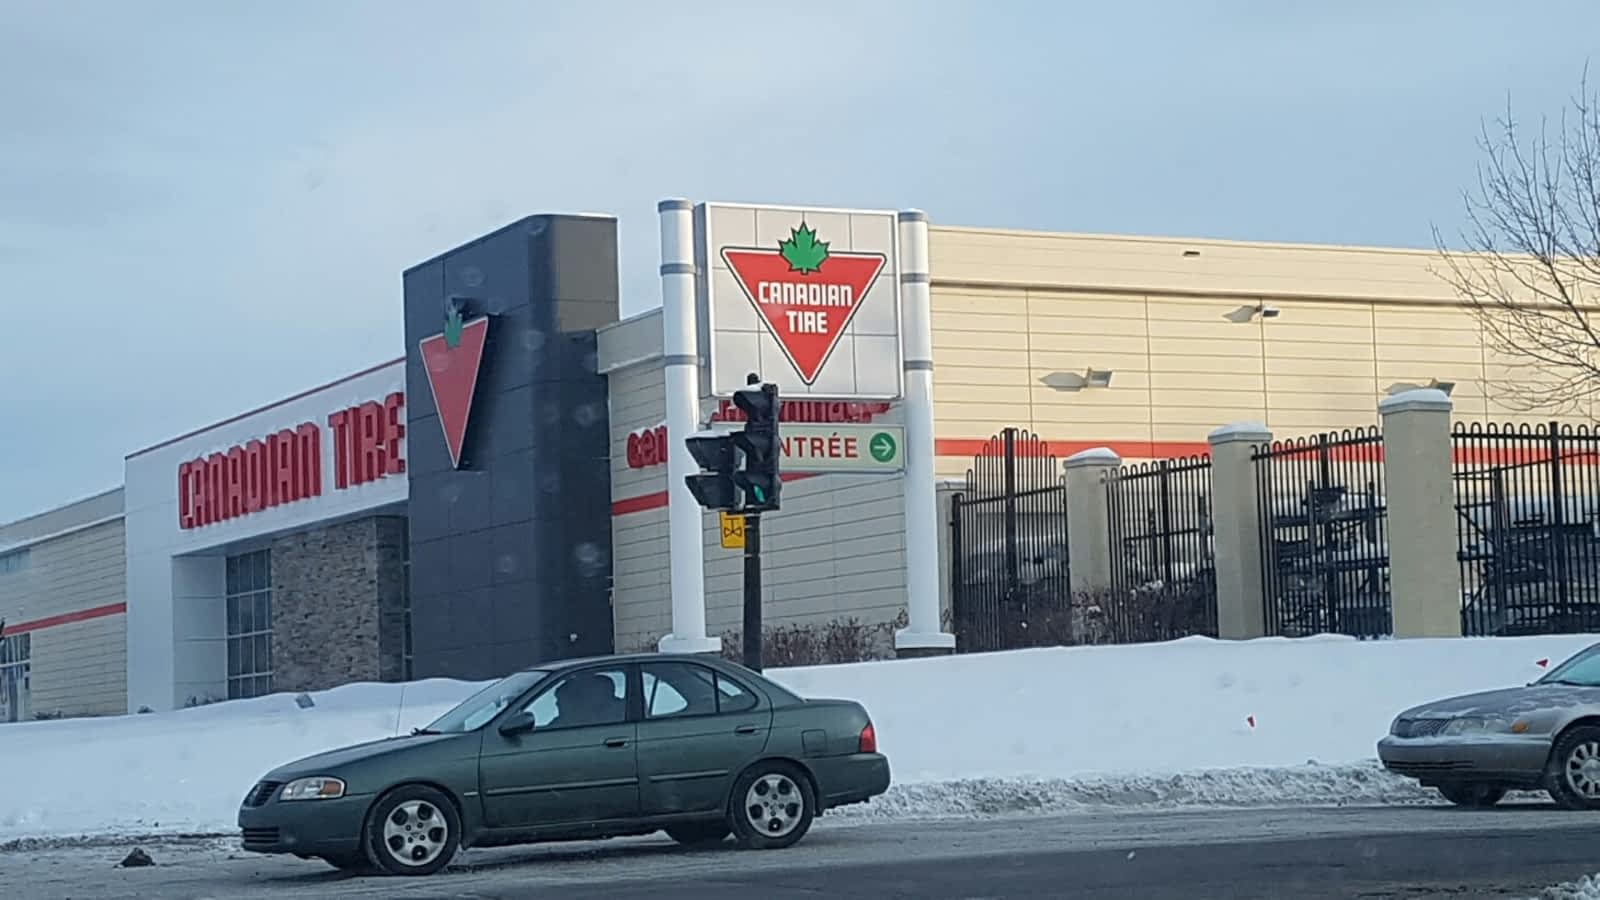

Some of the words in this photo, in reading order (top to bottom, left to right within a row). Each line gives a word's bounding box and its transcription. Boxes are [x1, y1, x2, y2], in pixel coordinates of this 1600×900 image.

[758, 281, 853, 307] CANADIAN
[785, 310, 828, 333] TIRE
[779, 432, 858, 458] NTRÉE
[178, 421, 321, 530] CANADIAN
[329, 391, 405, 489] TIRE
